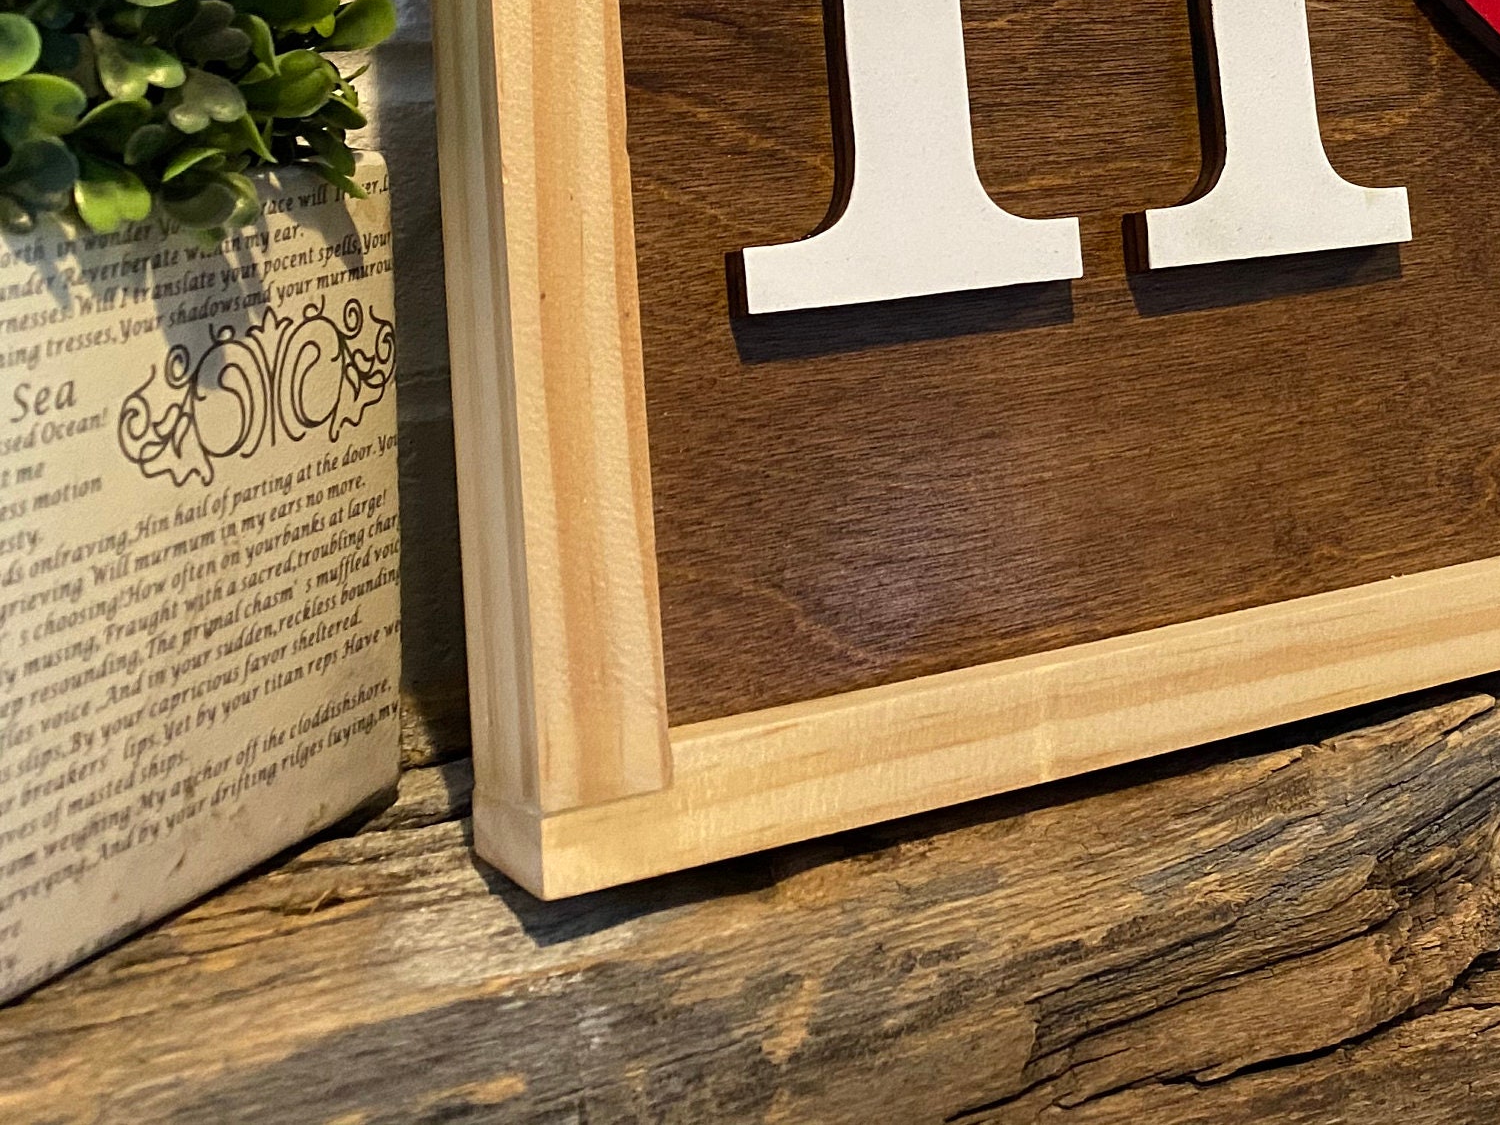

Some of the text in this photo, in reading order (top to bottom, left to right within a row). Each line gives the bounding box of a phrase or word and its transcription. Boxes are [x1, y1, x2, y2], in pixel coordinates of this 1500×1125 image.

[261, 196, 293, 217] race
[245, 232, 269, 253] my
[274, 223, 304, 241] ear.
[221, 263, 257, 292] your
[276, 279, 313, 307] your
[10, 380, 77, 423] Sea
[41, 407, 108, 444] Ocean!
[32, 476, 103, 512] motion
[211, 486, 231, 520] of
[229, 471, 294, 515] parting
[296, 463, 312, 484] at
[316, 452, 339, 476] the
[220, 521, 237, 539] in
[241, 510, 266, 535] my
[269, 498, 301, 522] ears
[305, 489, 324, 509] no
[327, 474, 366, 500] more.
[172, 559, 217, 595] often
[221, 550, 240, 570] on
[329, 506, 343, 527] at
[347, 489, 387, 520] large!
[316, 544, 372, 587] muffled
[226, 580, 236, 596] a
[239, 645, 287, 685] favor
[291, 604, 362, 655] sheltered.
[171, 650, 212, 687] your
[196, 703, 217, 729] by
[222, 685, 260, 723] your
[264, 665, 305, 695] titan
[342, 629, 380, 659] Have
[236, 734, 261, 768] off
[210, 762, 277, 807] drifting
